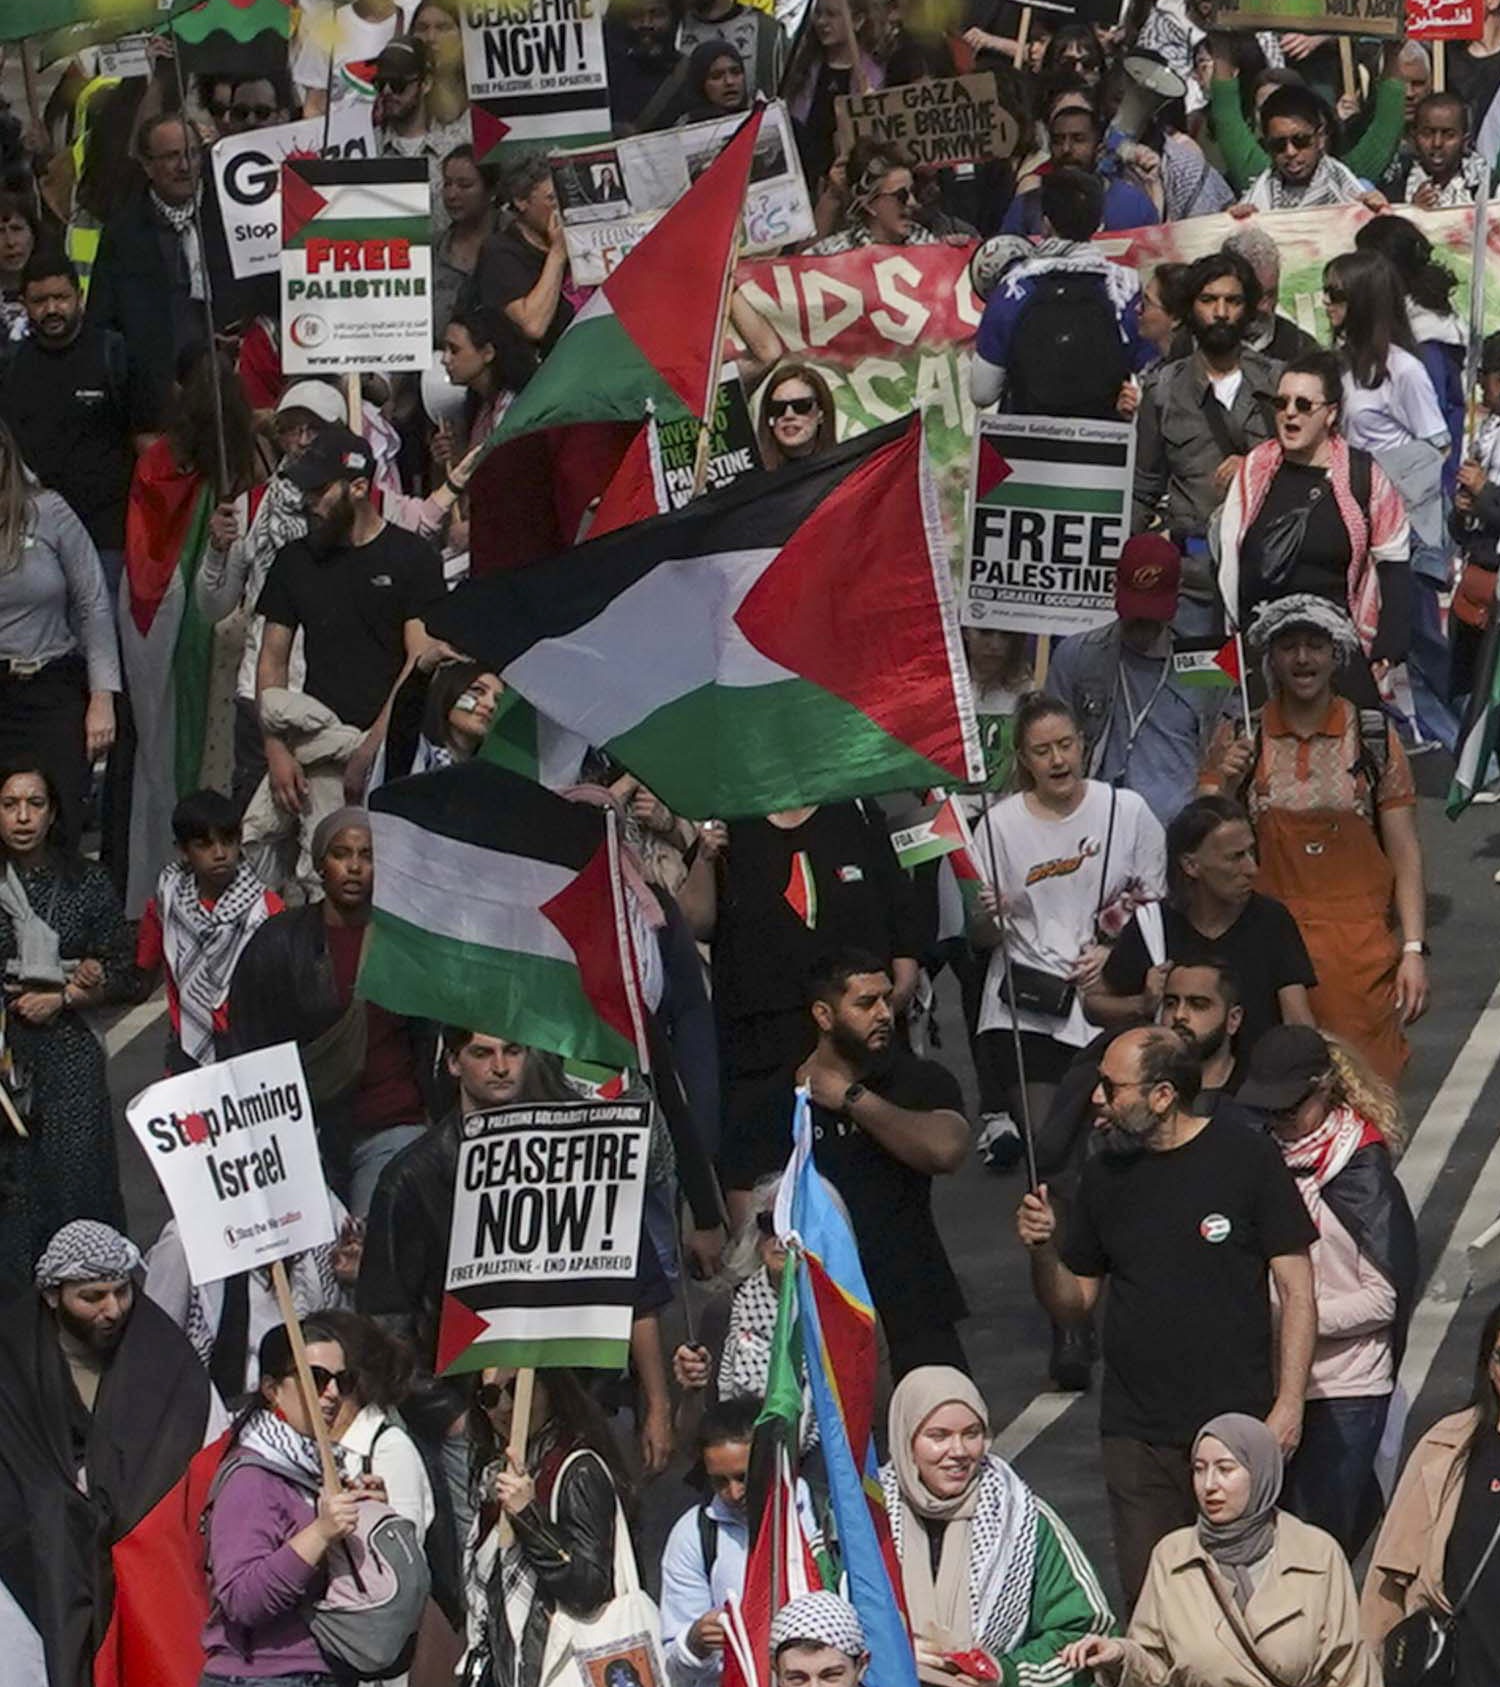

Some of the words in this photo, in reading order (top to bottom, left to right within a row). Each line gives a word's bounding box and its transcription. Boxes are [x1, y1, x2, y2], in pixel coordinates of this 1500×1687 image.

[485, 22, 586, 80] NOW!
[846, 92, 887, 118] LET
[902, 80, 970, 110] GAZA
[914, 102, 997, 137] BREATHE
[908, 131, 996, 164] SURVIVE
[234, 221, 278, 244] Stop
[305, 237, 411, 275] FREE
[286, 277, 428, 301] PALESTINE
[972, 507, 1123, 568] FREE
[970, 559, 1116, 595] PALESTINE
[146, 1110, 221, 1155] Stp
[221, 1081, 304, 1134] Arming
[206, 1135, 287, 1201] Israel
[464, 1132, 641, 1192] CEASEFIRE
[473, 1182, 620, 1258] NOW!
